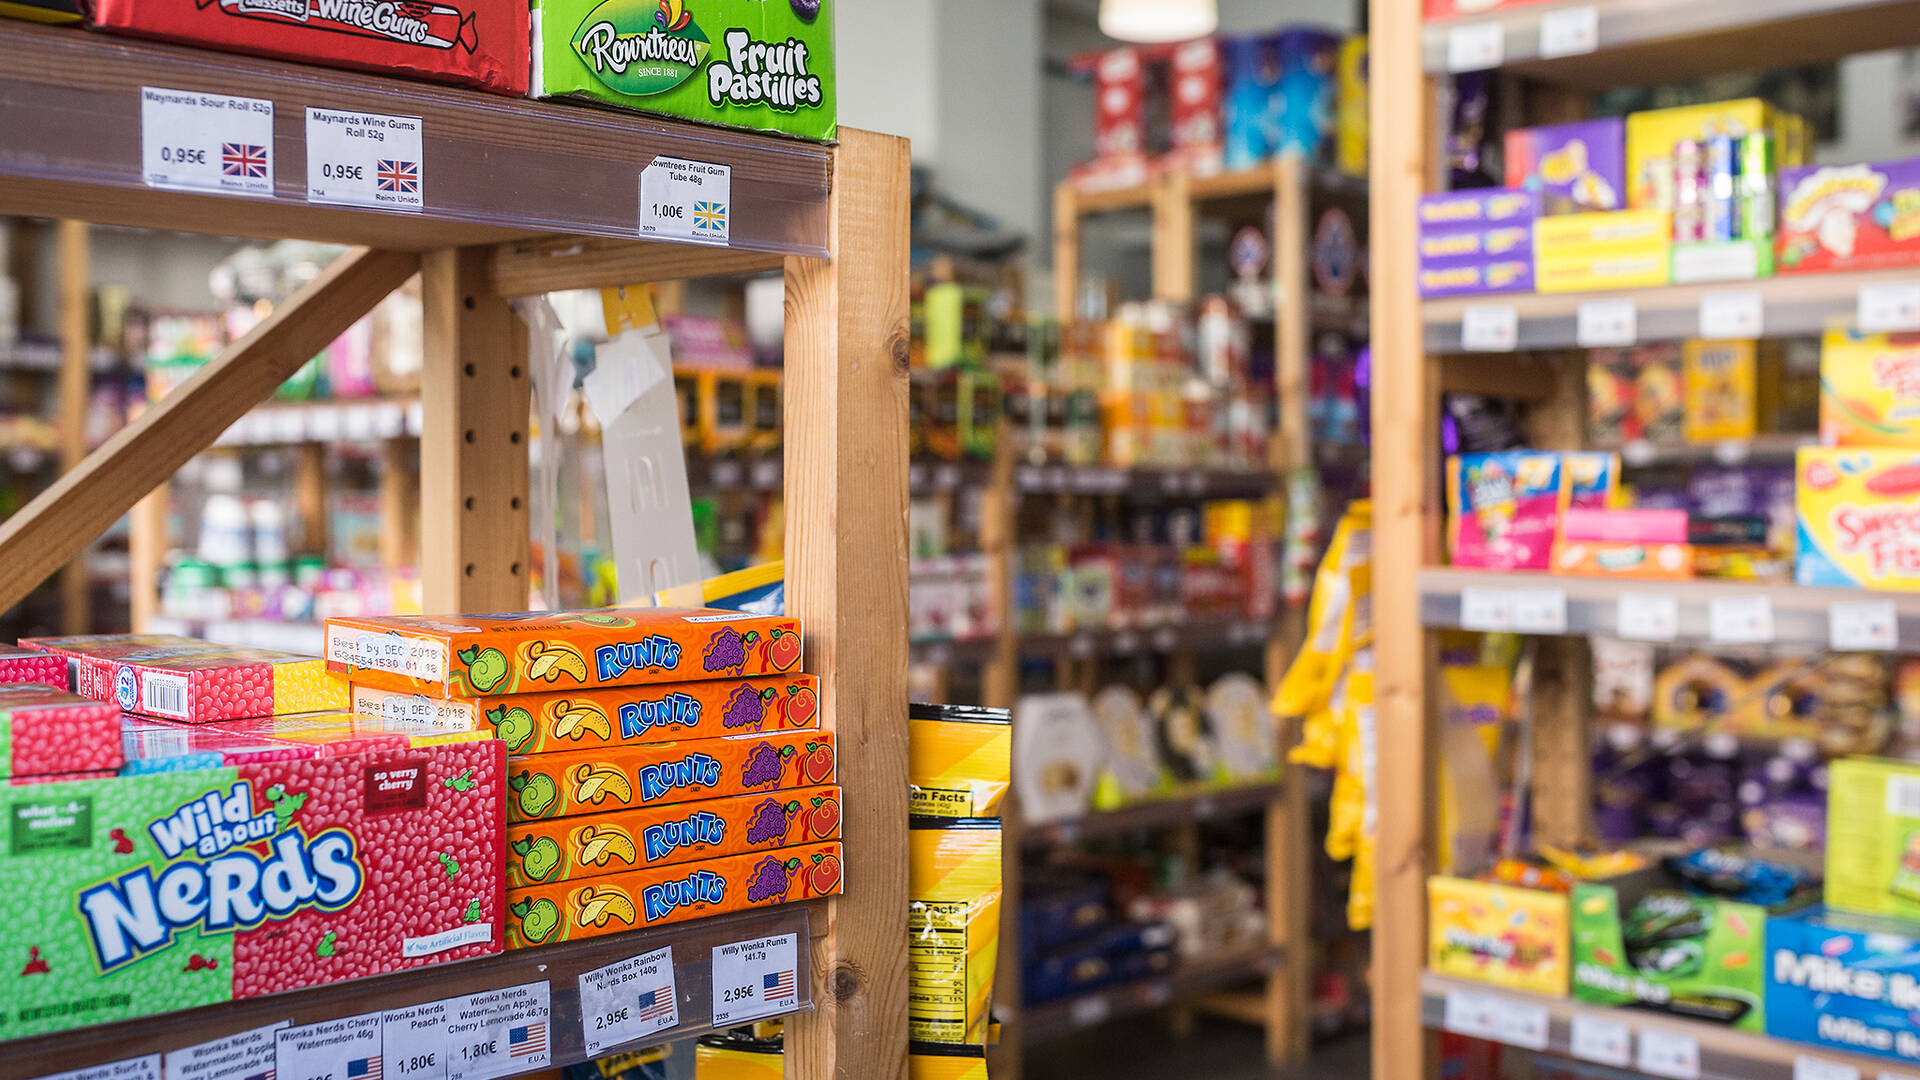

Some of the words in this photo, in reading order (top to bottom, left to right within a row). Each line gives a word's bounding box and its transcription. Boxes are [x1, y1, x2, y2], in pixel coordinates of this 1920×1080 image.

[581, 20, 698, 74] Rowntrees
[726, 31, 808, 76] Fruit
[638, 68, 661, 77] SINCE
[663, 67, 678, 78] 1881
[708, 63, 822, 107] Pastilles
[200, 96, 224, 109] Sour
[228, 99, 249, 111] Roll
[252, 101, 271, 116] 52g
[313, 111, 359, 126] Maynards
[362, 116, 386, 128] Wine
[388, 119, 416, 131] Gums
[345, 127, 365, 138] Roll
[367, 129, 384, 142] 52g
[161, 146, 206, 166] 0,95€
[323, 163, 363, 180] 0,95€
[650, 160, 687, 171] owntrees
[688, 163, 707, 174] Fruit
[707, 166, 725, 177] Gum
[669, 171, 688, 182] Tube
[689, 174, 703, 186] 48g
[375, 193, 396, 203] Reino
[397, 195, 419, 205] Unido
[652, 203, 683, 219] 1,00€
[333, 637, 359, 650] Best
[366, 643, 379, 655] by
[385, 644, 404, 656] DEC
[410, 647, 438, 660] 2018
[595, 634, 682, 682] RUNTS
[358, 699, 385, 711] Best
[392, 704, 406, 715] by
[412, 705, 432, 716] DEC
[437, 707, 465, 719] 2018
[618, 692, 703, 740] RUNTS
[374, 772, 388, 781] so
[389, 768, 418, 780] verry
[639, 752, 722, 803] RUNTS
[378, 779, 414, 792] cherry
[931, 792, 966, 803] Facts
[150, 783, 250, 858] Wild
[198, 812, 276, 856] about
[643, 810, 727, 862] RUNTS
[642, 869, 727, 922] RUNTS
[416, 943, 428, 951] No
[723, 946, 740, 955] Willy
[740, 940, 765, 951] Wonka
[766, 937, 788, 947] Runts
[605, 963, 633, 977] Wonka
[633, 952, 667, 968] Rainbow
[744, 951, 766, 961] 141.7g
[622, 972, 638, 983] Box
[639, 965, 658, 976] 140g
[1774, 948, 1884, 1000] Mike
[470, 995, 500, 1006] Wonka
[501, 988, 528, 1001] Nerds
[723, 985, 754, 1003] 2,95€
[384, 1013, 417, 1023] Wonka
[417, 1003, 445, 1017] Nerds
[512, 998, 538, 1010] Apple
[411, 1018, 439, 1030] Peach
[595, 1007, 629, 1030] 2,95€
[715, 1012, 729, 1020] 2335
[280, 1029, 314, 1042] Wonka
[316, 1023, 346, 1035] Nerds
[347, 1017, 380, 1029] Cherry
[448, 1022, 479, 1034] Cherry
[1817, 1014, 1893, 1050] Mike
[297, 1032, 355, 1051] Watermelon
[588, 1041, 600, 1050] 279
[398, 1052, 436, 1075] 1,80€
